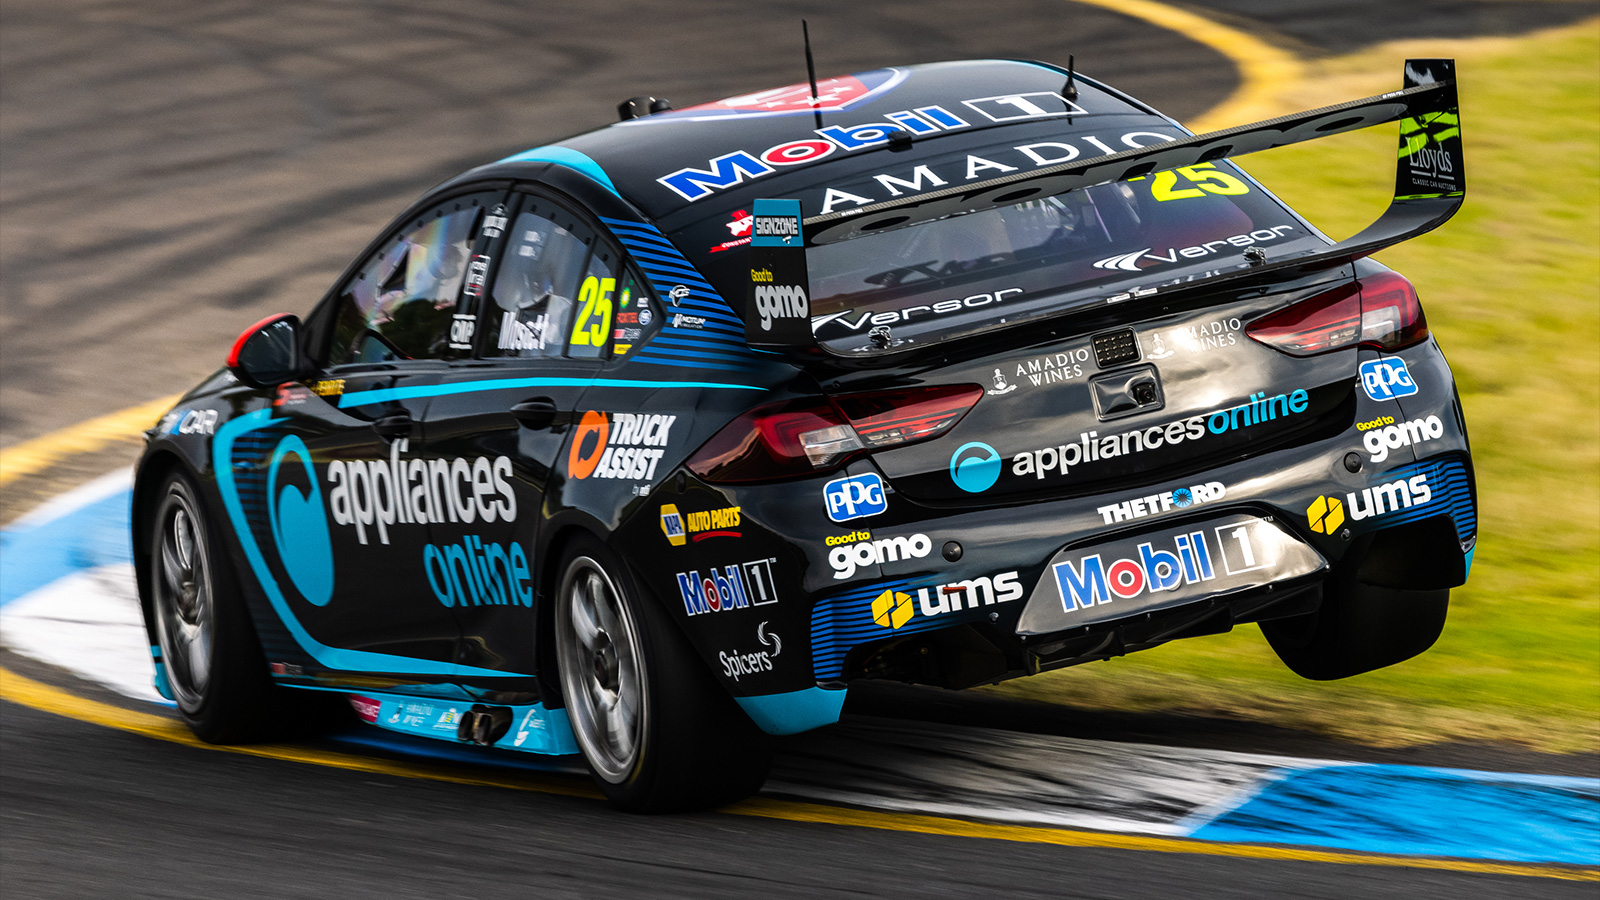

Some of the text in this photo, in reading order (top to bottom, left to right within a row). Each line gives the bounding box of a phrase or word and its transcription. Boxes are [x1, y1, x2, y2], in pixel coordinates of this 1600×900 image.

[656, 105, 971, 202] Mobil
[1405, 136, 1453, 178] Lloyds
[1127, 162, 1250, 202] 25
[755, 217, 798, 235] SIGNZONE
[750, 267, 773, 282] Good to
[570, 275, 616, 347] 25
[755, 284, 808, 331] gomo
[1178, 317, 1241, 342] MADIO
[1016, 348, 1089, 377] AMADIO
[1028, 364, 1083, 387] WINES
[1364, 363, 1412, 396] PPG
[609, 413, 676, 446] TRUCK
[1012, 388, 1309, 480] appliances online
[1356, 415, 1395, 432] Good to
[1363, 415, 1444, 463] gomo
[592, 447, 665, 480] ASSIST
[327, 437, 517, 545] appliances
[828, 481, 883, 515] PPG
[1097, 481, 1226, 525] THETFORD
[1346, 474, 1432, 521] ums
[687, 511, 711, 532] AUTO
[711, 506, 741, 530] PARTS
[825, 531, 870, 546] Good to
[422, 534, 533, 608] online
[828, 533, 932, 580] gomo
[1052, 530, 1216, 613] Mobil
[676, 564, 750, 616] Mobil
[917, 571, 1024, 617] ums
[719, 649, 773, 681] Spicers
